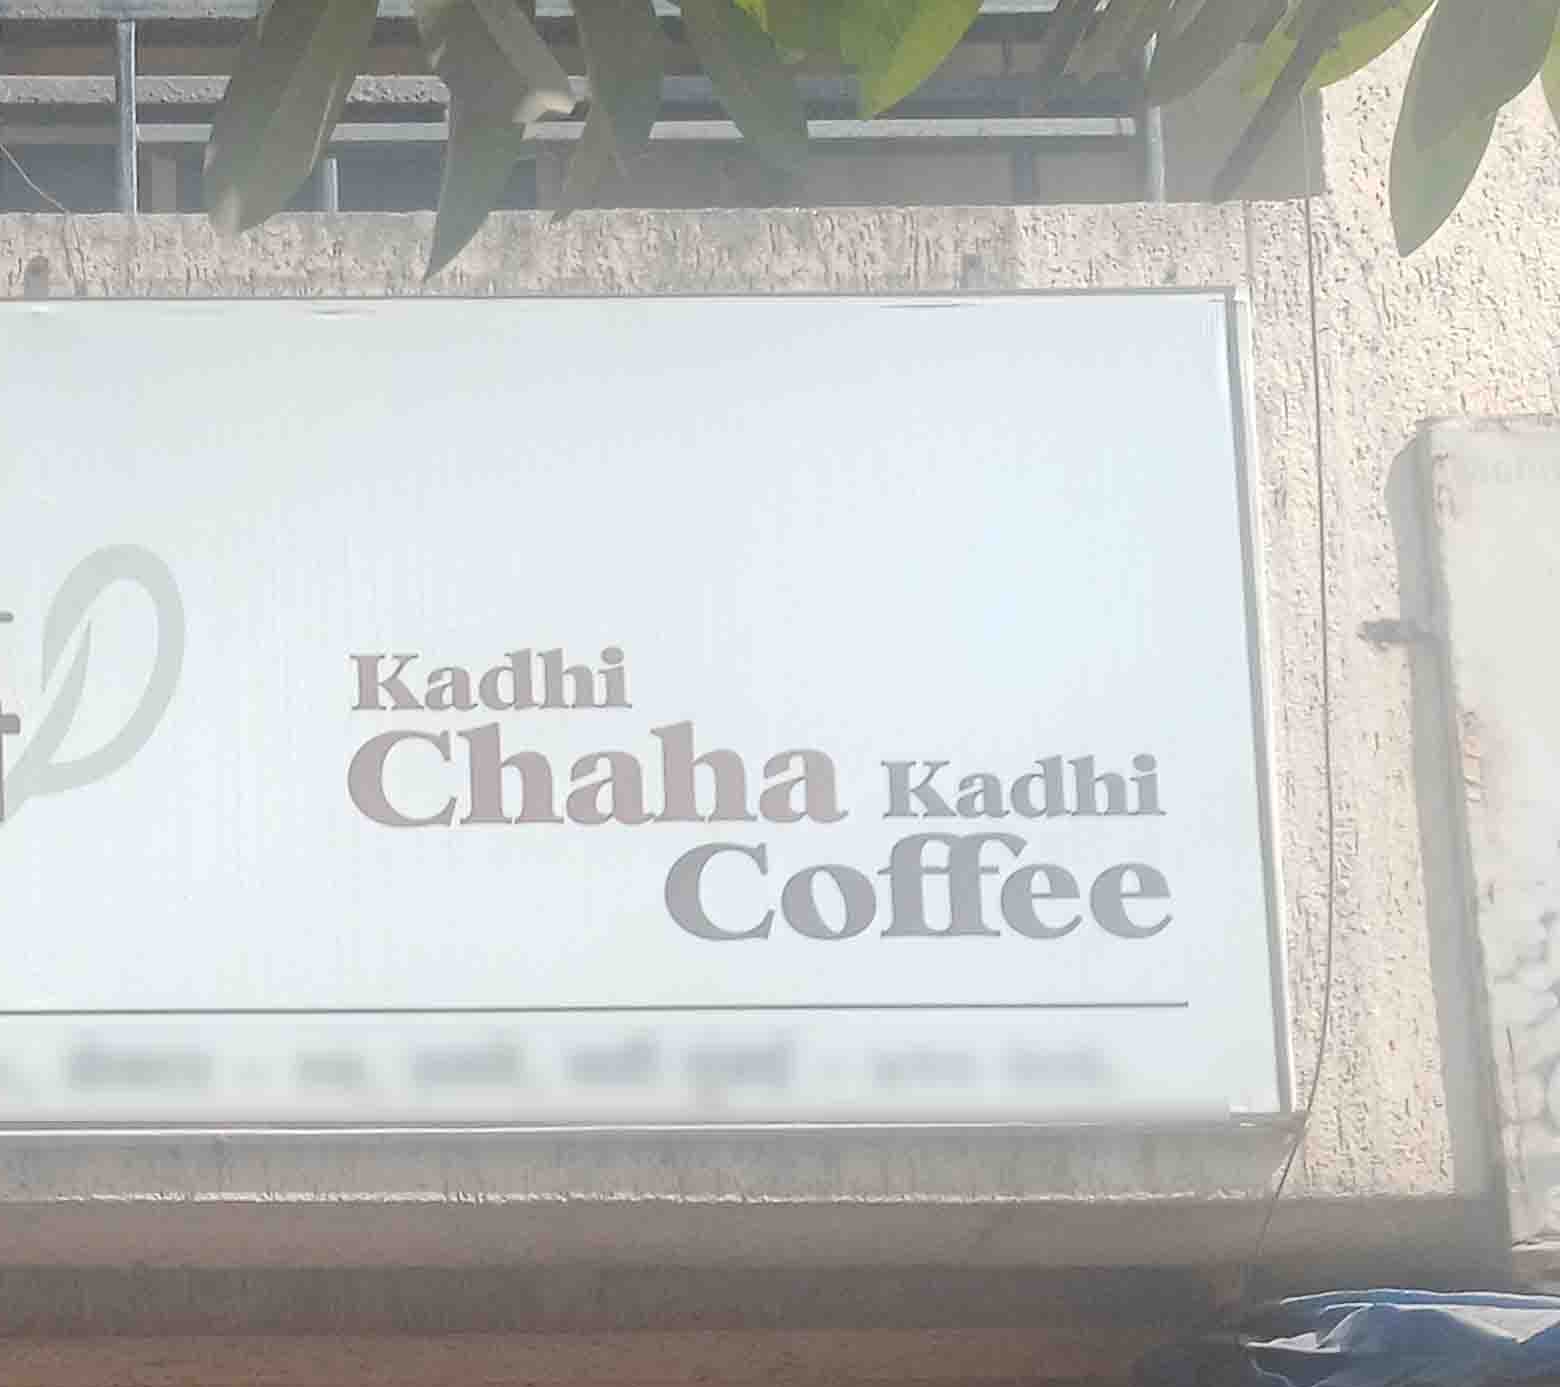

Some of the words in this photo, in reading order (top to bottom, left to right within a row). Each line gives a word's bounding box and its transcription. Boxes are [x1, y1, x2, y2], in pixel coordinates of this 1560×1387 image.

[349, 647, 632, 712] Kadhi
[347, 719, 849, 830] Chaha
[881, 753, 1166, 820] Kadhi
[663, 832, 1174, 941] Coffee
